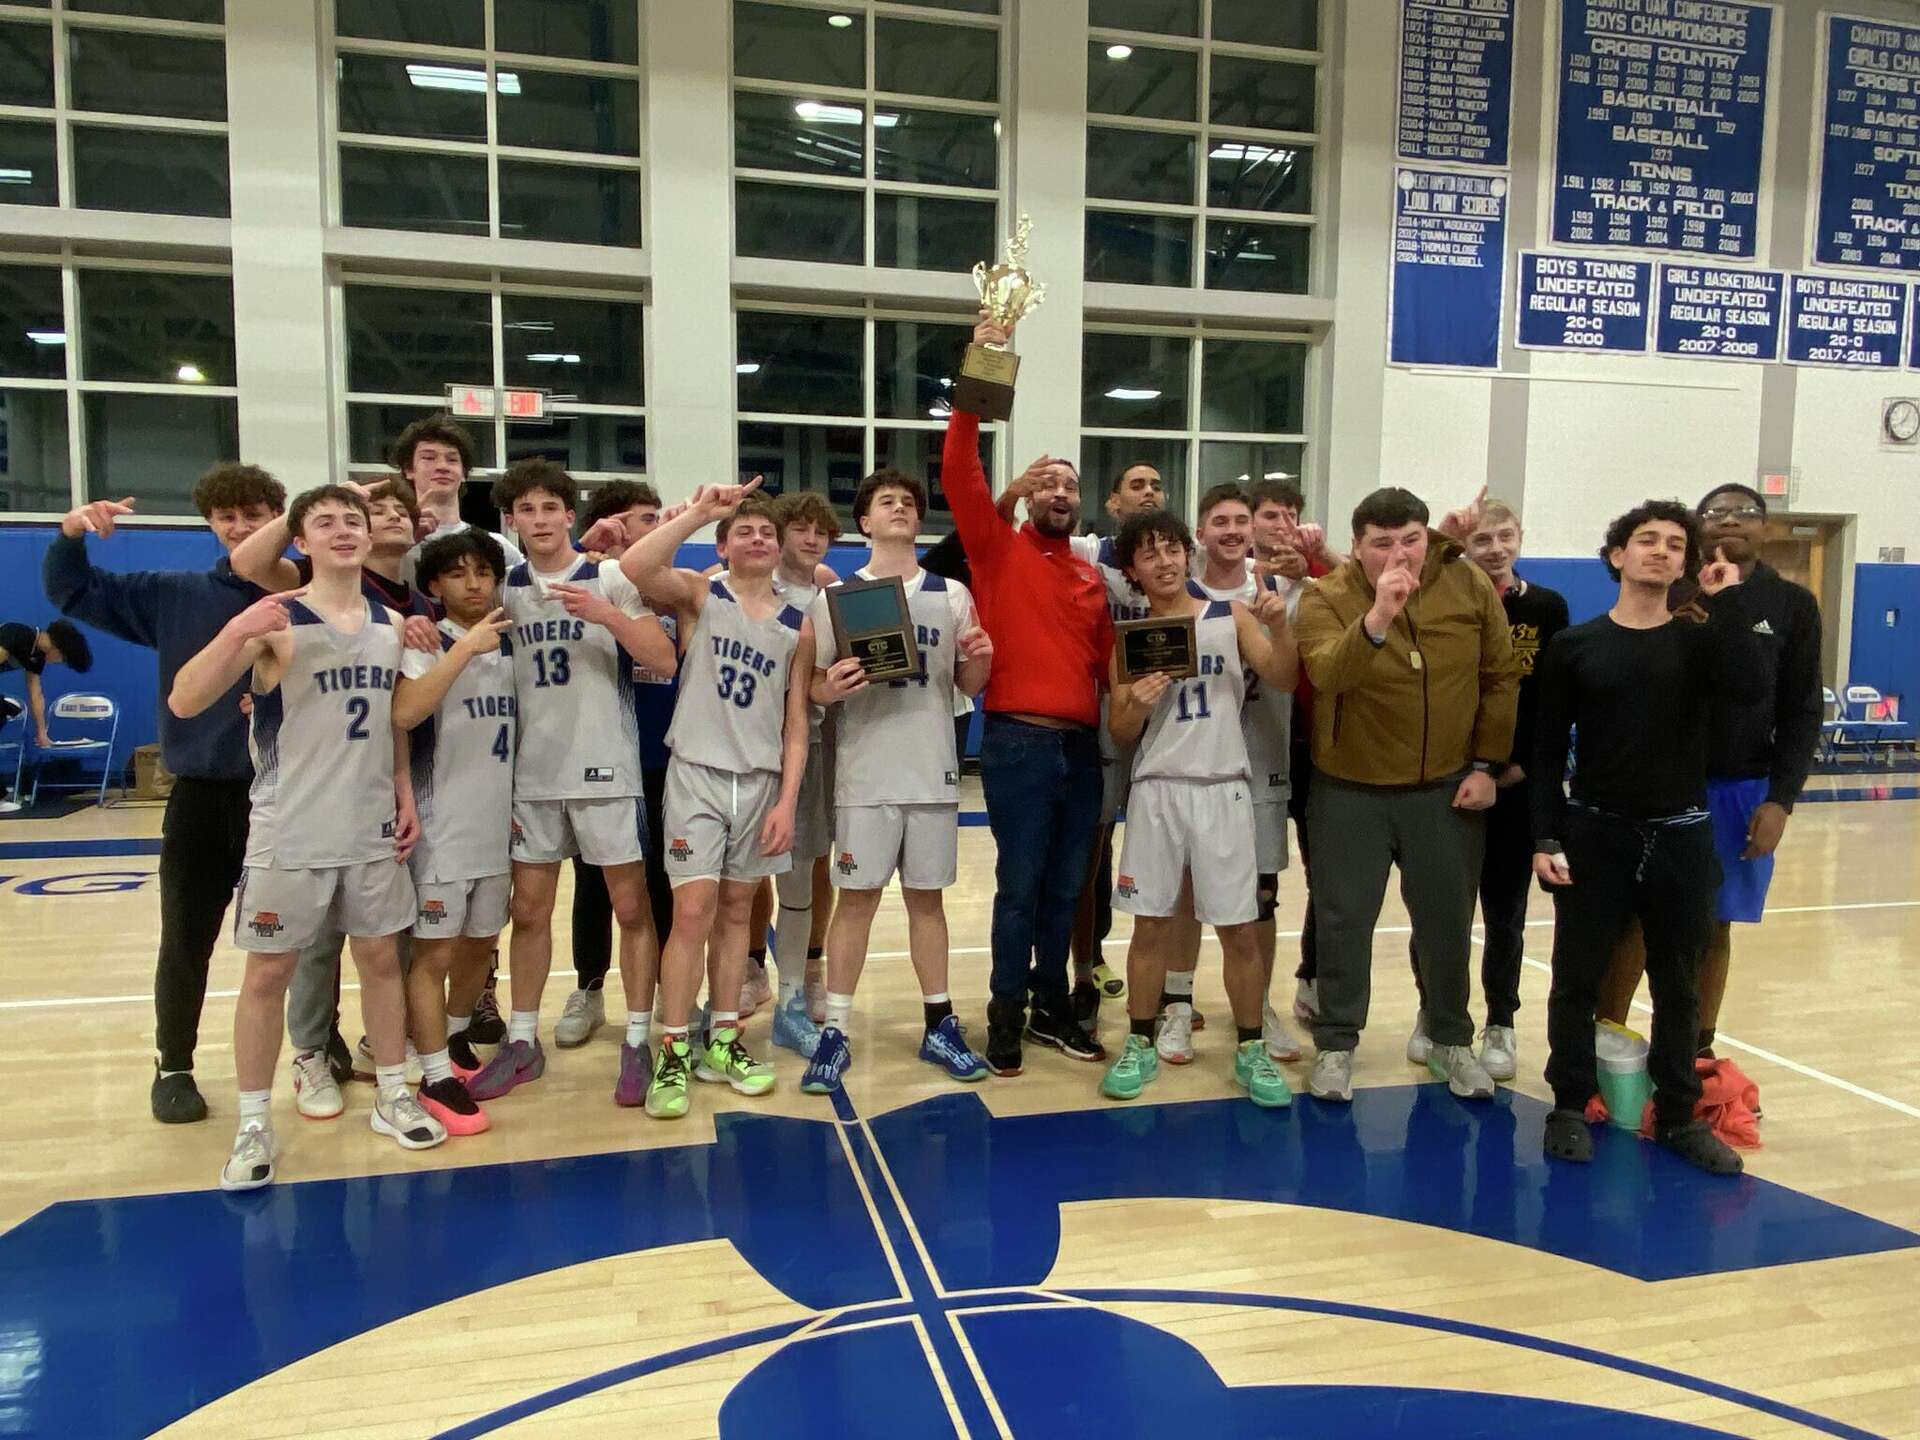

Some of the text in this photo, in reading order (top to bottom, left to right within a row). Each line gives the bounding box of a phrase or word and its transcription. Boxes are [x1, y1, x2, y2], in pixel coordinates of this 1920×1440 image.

[1674, 1, 1748, 26] CONFERENCE
[1586, 9, 1746, 48] BOYS CHAMPIONSHIPS
[1591, 38, 1740, 71] CROSS COUNTRY
[1848, 46, 1888, 70] GIRLS
[1855, 72, 1909, 93] CROSS
[1602, 90, 1724, 118] BASKETBALL
[1612, 125, 1710, 150] BASEBALL
[1629, 160, 1692, 182] TENNIS
[1433, 193, 1457, 212] POINT
[1462, 196, 1500, 216] SCORERS
[1590, 193, 1724, 220] TRACK & FIELD
[1720, 224, 1742, 238] 2001
[1851, 214, 1907, 234] TRACK
[1536, 258, 1636, 280] BOYS TENNIS
[1667, 268, 1776, 292] GIRLS BASKETBALL
[1536, 276, 1635, 298] UNDEFEATED
[1674, 287, 1766, 308] UNDEFEATED
[1796, 278, 1900, 300] BOYS BASKETBALL
[1530, 294, 1640, 317] REGULAR SEASON
[1670, 304, 1770, 326] REGULAR SEASON
[1803, 296, 1892, 317] UNDEFEATED
[1566, 316, 1603, 330] 20-0
[1700, 325, 1736, 339] 20-0
[1798, 314, 1897, 335] REGULAR SEASON
[1563, 331, 1604, 346] 2000
[1678, 339, 1758, 355] 2007-2008
[1828, 334, 1864, 348] 20-0
[1808, 348, 1882, 364] 2017-2018
[517, 619, 585, 647] TIGERS
[532, 646, 571, 688] 13
[712, 636, 776, 678] TIGERS
[314, 665, 394, 694] TIGERS
[717, 664, 757, 708] 33
[1176, 681, 1212, 724] 11
[345, 696, 370, 740] 2
[491, 722, 509, 763] 4
